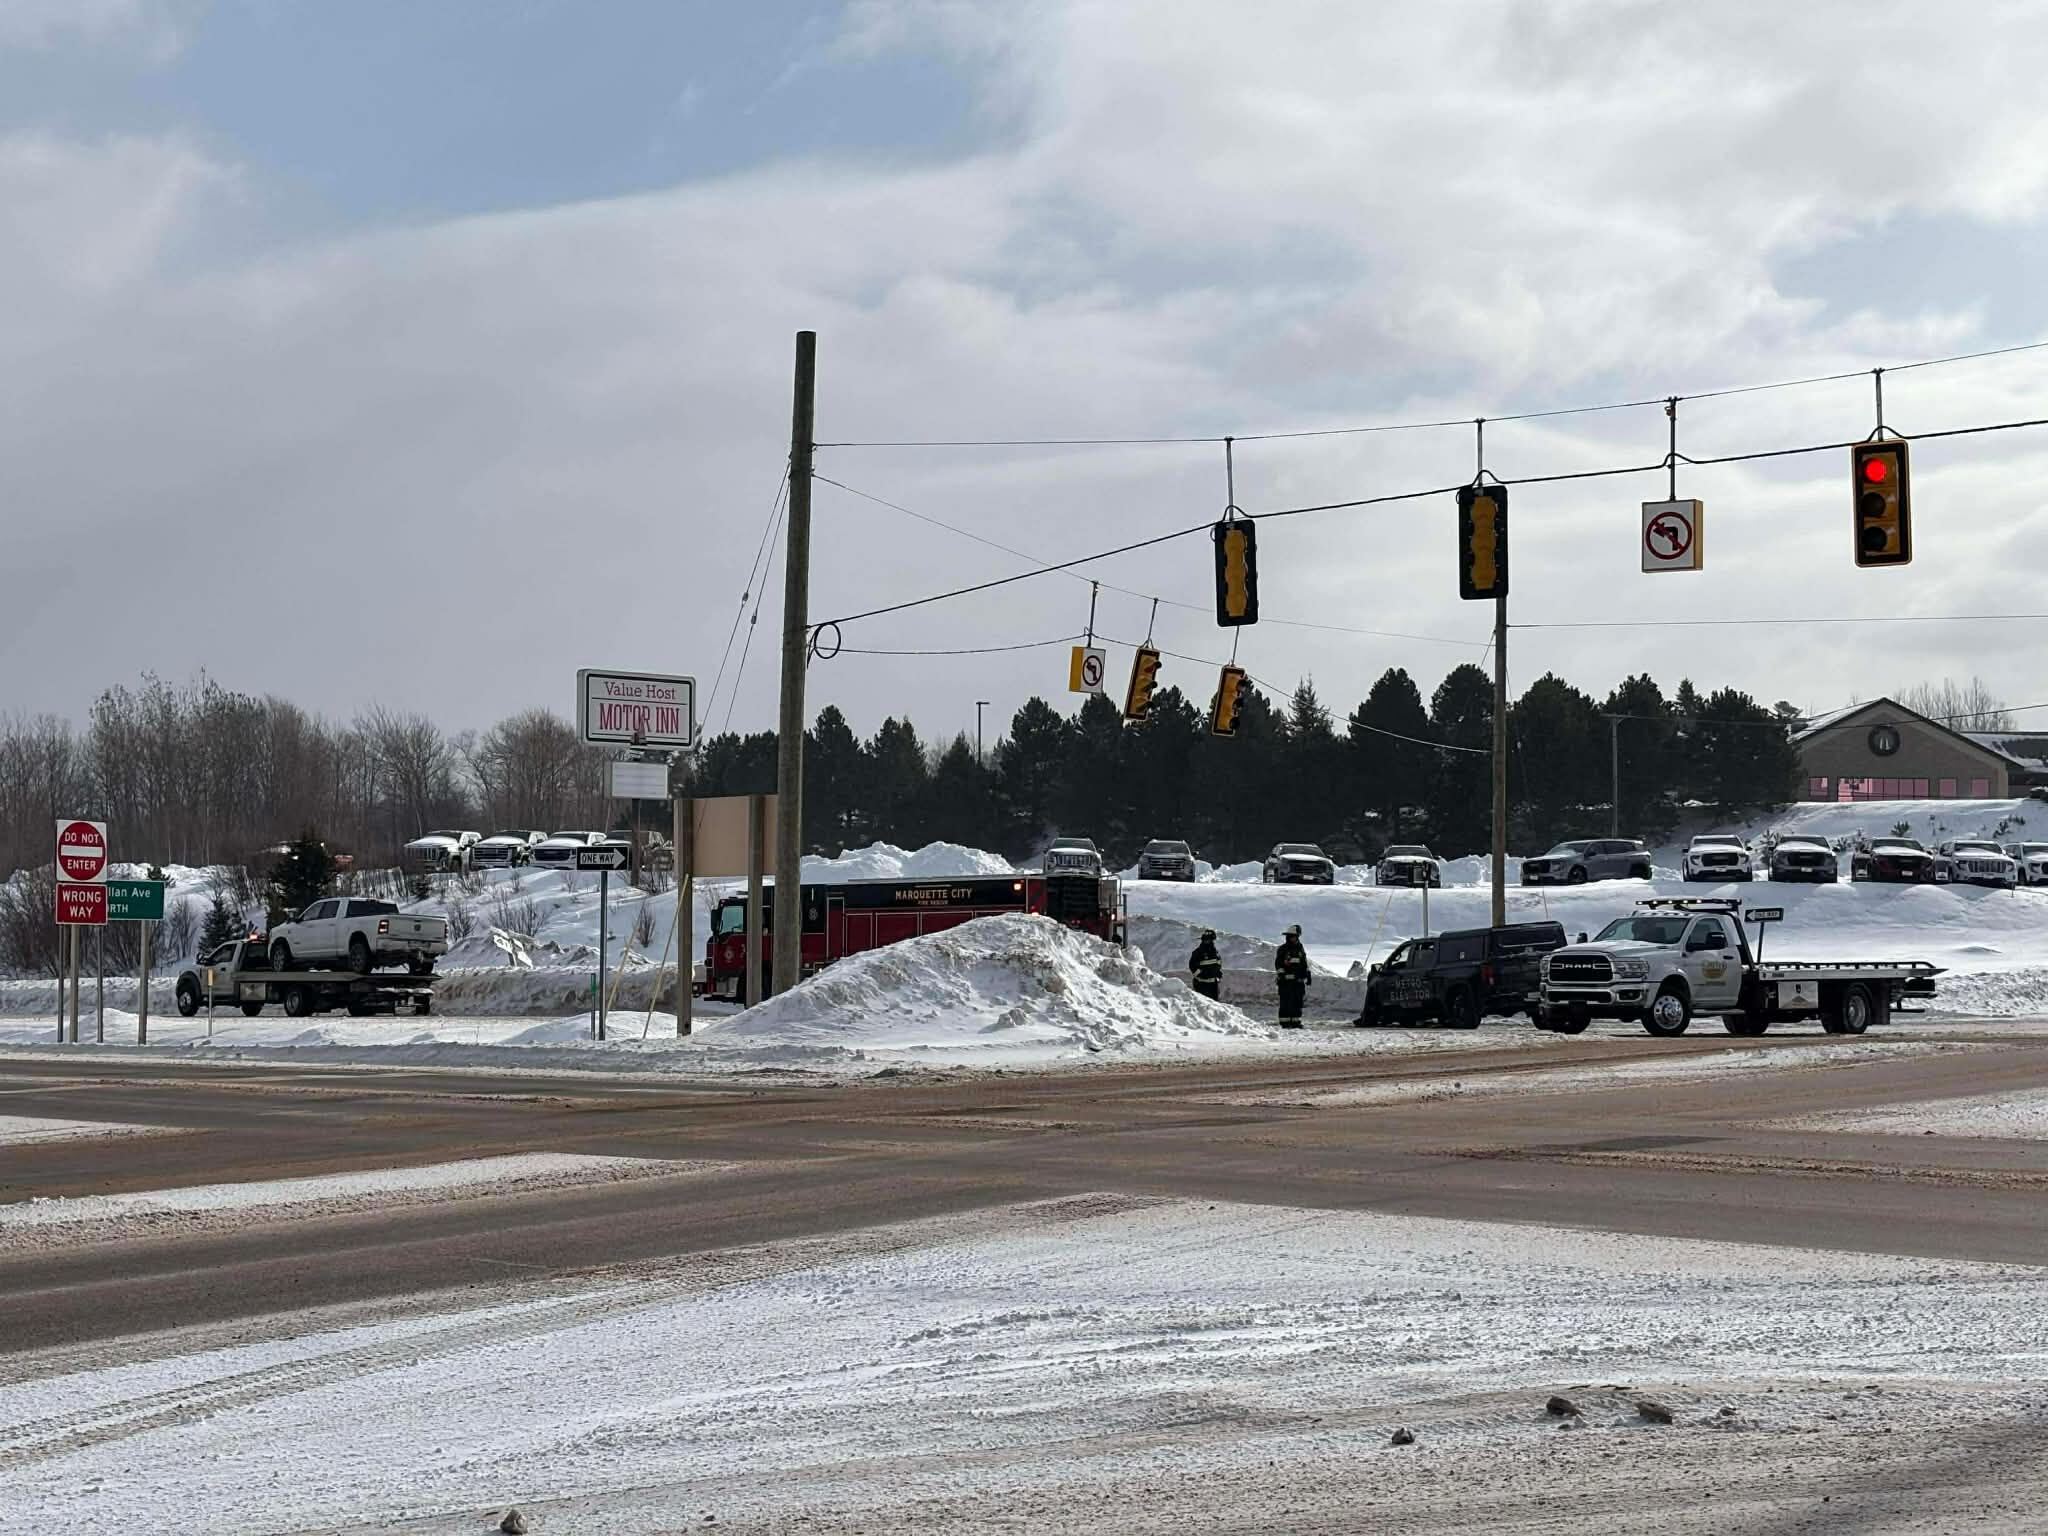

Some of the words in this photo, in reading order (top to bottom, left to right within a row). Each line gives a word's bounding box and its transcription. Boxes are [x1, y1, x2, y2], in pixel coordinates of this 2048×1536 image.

[604, 681, 642, 697] Value
[646, 685, 678, 700] Host
[599, 703, 651, 733] MOTOR
[656, 706, 680, 734] INN
[64, 832, 77, 842] DO
[82, 834, 99, 843] NOT
[582, 854, 597, 863] ONE
[600, 855, 615, 863] WAY
[67, 860, 97, 870] ENTER
[62, 891, 101, 902] WRONG
[108, 888, 128, 897] llan
[131, 888, 151, 898] Ave
[895, 889, 949, 900] MARQUETTE
[951, 888, 973, 899] CITY
[70, 907, 94, 917] WAY
